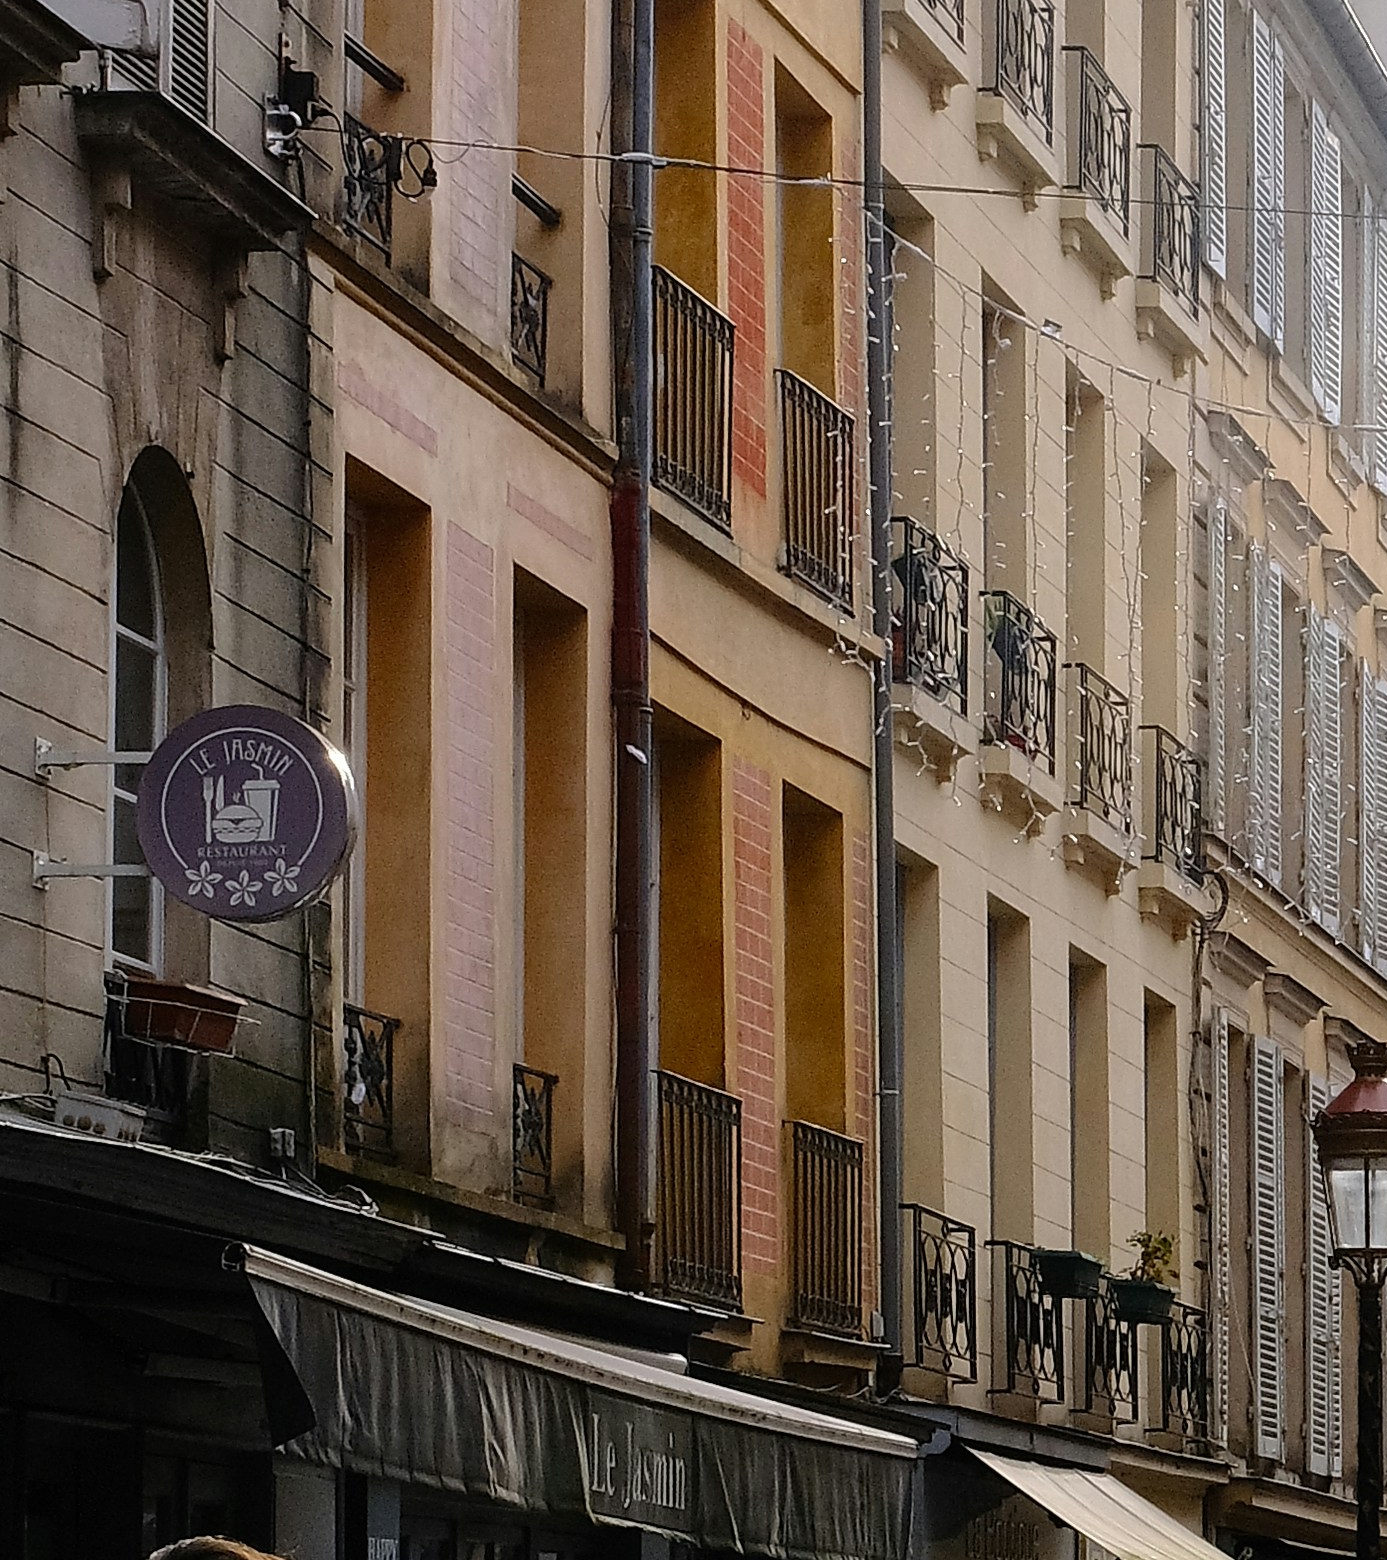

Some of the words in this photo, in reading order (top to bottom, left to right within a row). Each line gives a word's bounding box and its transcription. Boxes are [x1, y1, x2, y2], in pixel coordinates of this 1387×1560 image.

[189, 748, 217, 776] LE
[197, 844, 287, 859] RESTAURANT
[591, 1412, 616, 1497] Le
[621, 1421, 686, 1511] Jasmin
